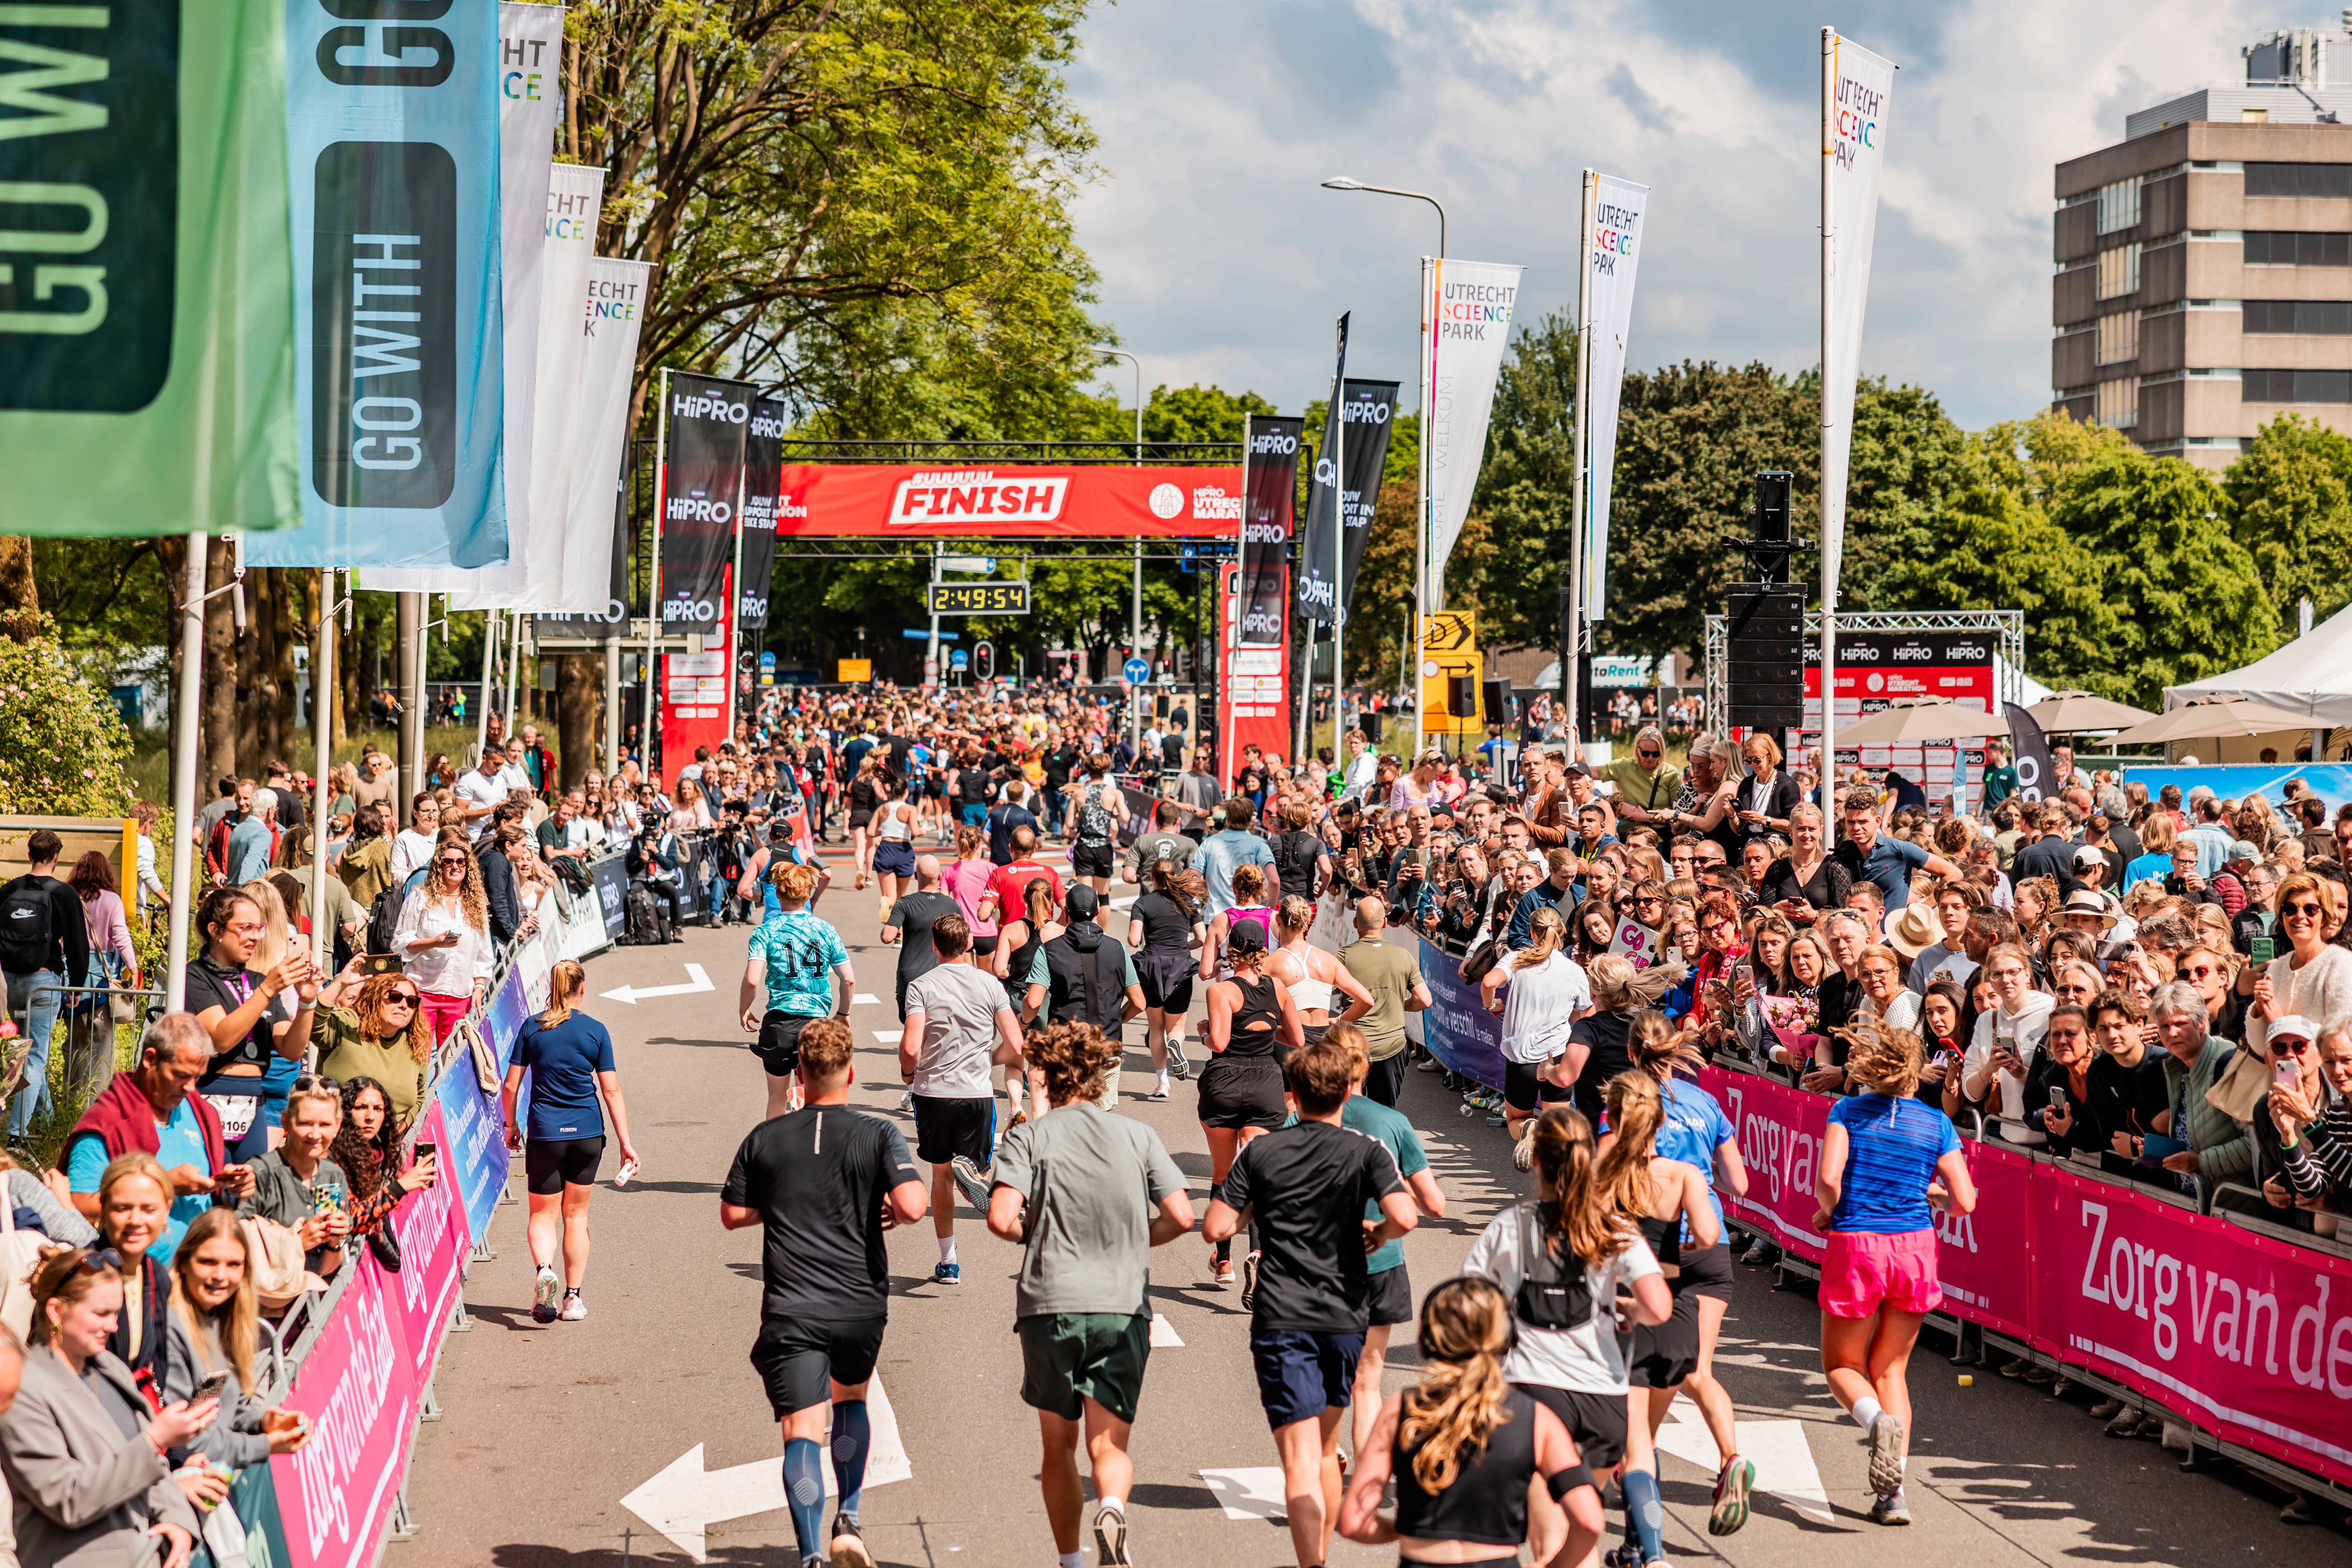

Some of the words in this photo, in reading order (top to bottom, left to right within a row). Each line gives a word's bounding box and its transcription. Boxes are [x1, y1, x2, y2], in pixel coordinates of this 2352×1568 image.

[1597, 202, 1638, 232] UTRECHT
[588, 280, 638, 300] ECHT
[1445, 282, 1515, 303] UTRECHT
[353, 233, 421, 377] WITH
[1443, 302, 1512, 323] SCIENCE
[1442, 322, 1485, 341] PARK
[673, 394, 749, 424] HiPRO
[352, 396, 422, 470] GO
[1435, 376, 1454, 471] WELKOM
[1249, 434, 1297, 455] HiPRO
[750, 495, 772, 507] JOUW
[901, 485, 1055, 516] FINISH
[1193, 497, 1241, 508] UTREC
[1343, 490, 1361, 503] OUW
[667, 497, 731, 523] HiPRO
[744, 507, 772, 518] UPPORT
[1360, 504, 1375, 517] IN
[758, 517, 777, 530] STAP
[1245, 525, 1285, 544] HiPRO
[1434, 490, 1446, 579] ELCOME
[935, 588, 1023, 610] 2:49:54
[663, 599, 715, 622] HiPRO
[1242, 613, 1282, 634] HiPRO
[1804, 649, 1821, 660] PRO
[1841, 647, 1879, 661] HiPRO
[1893, 647, 1933, 660] HiPRO
[1946, 646, 1985, 660] HiPRO
[1594, 664, 1640, 677] toRent
[1965, 755, 1983, 763] PRO
[1622, 924, 1645, 951] GO
[782, 939, 824, 979] 14
[1449, 1009, 1475, 1039] verschil
[1727, 1087, 1780, 1203] Zorg
[1782, 1120, 1824, 1198] va
[2081, 1199, 2181, 1361] Zorg
[2187, 1265, 2279, 1375] van
[2291, 1274, 2352, 1400] de
